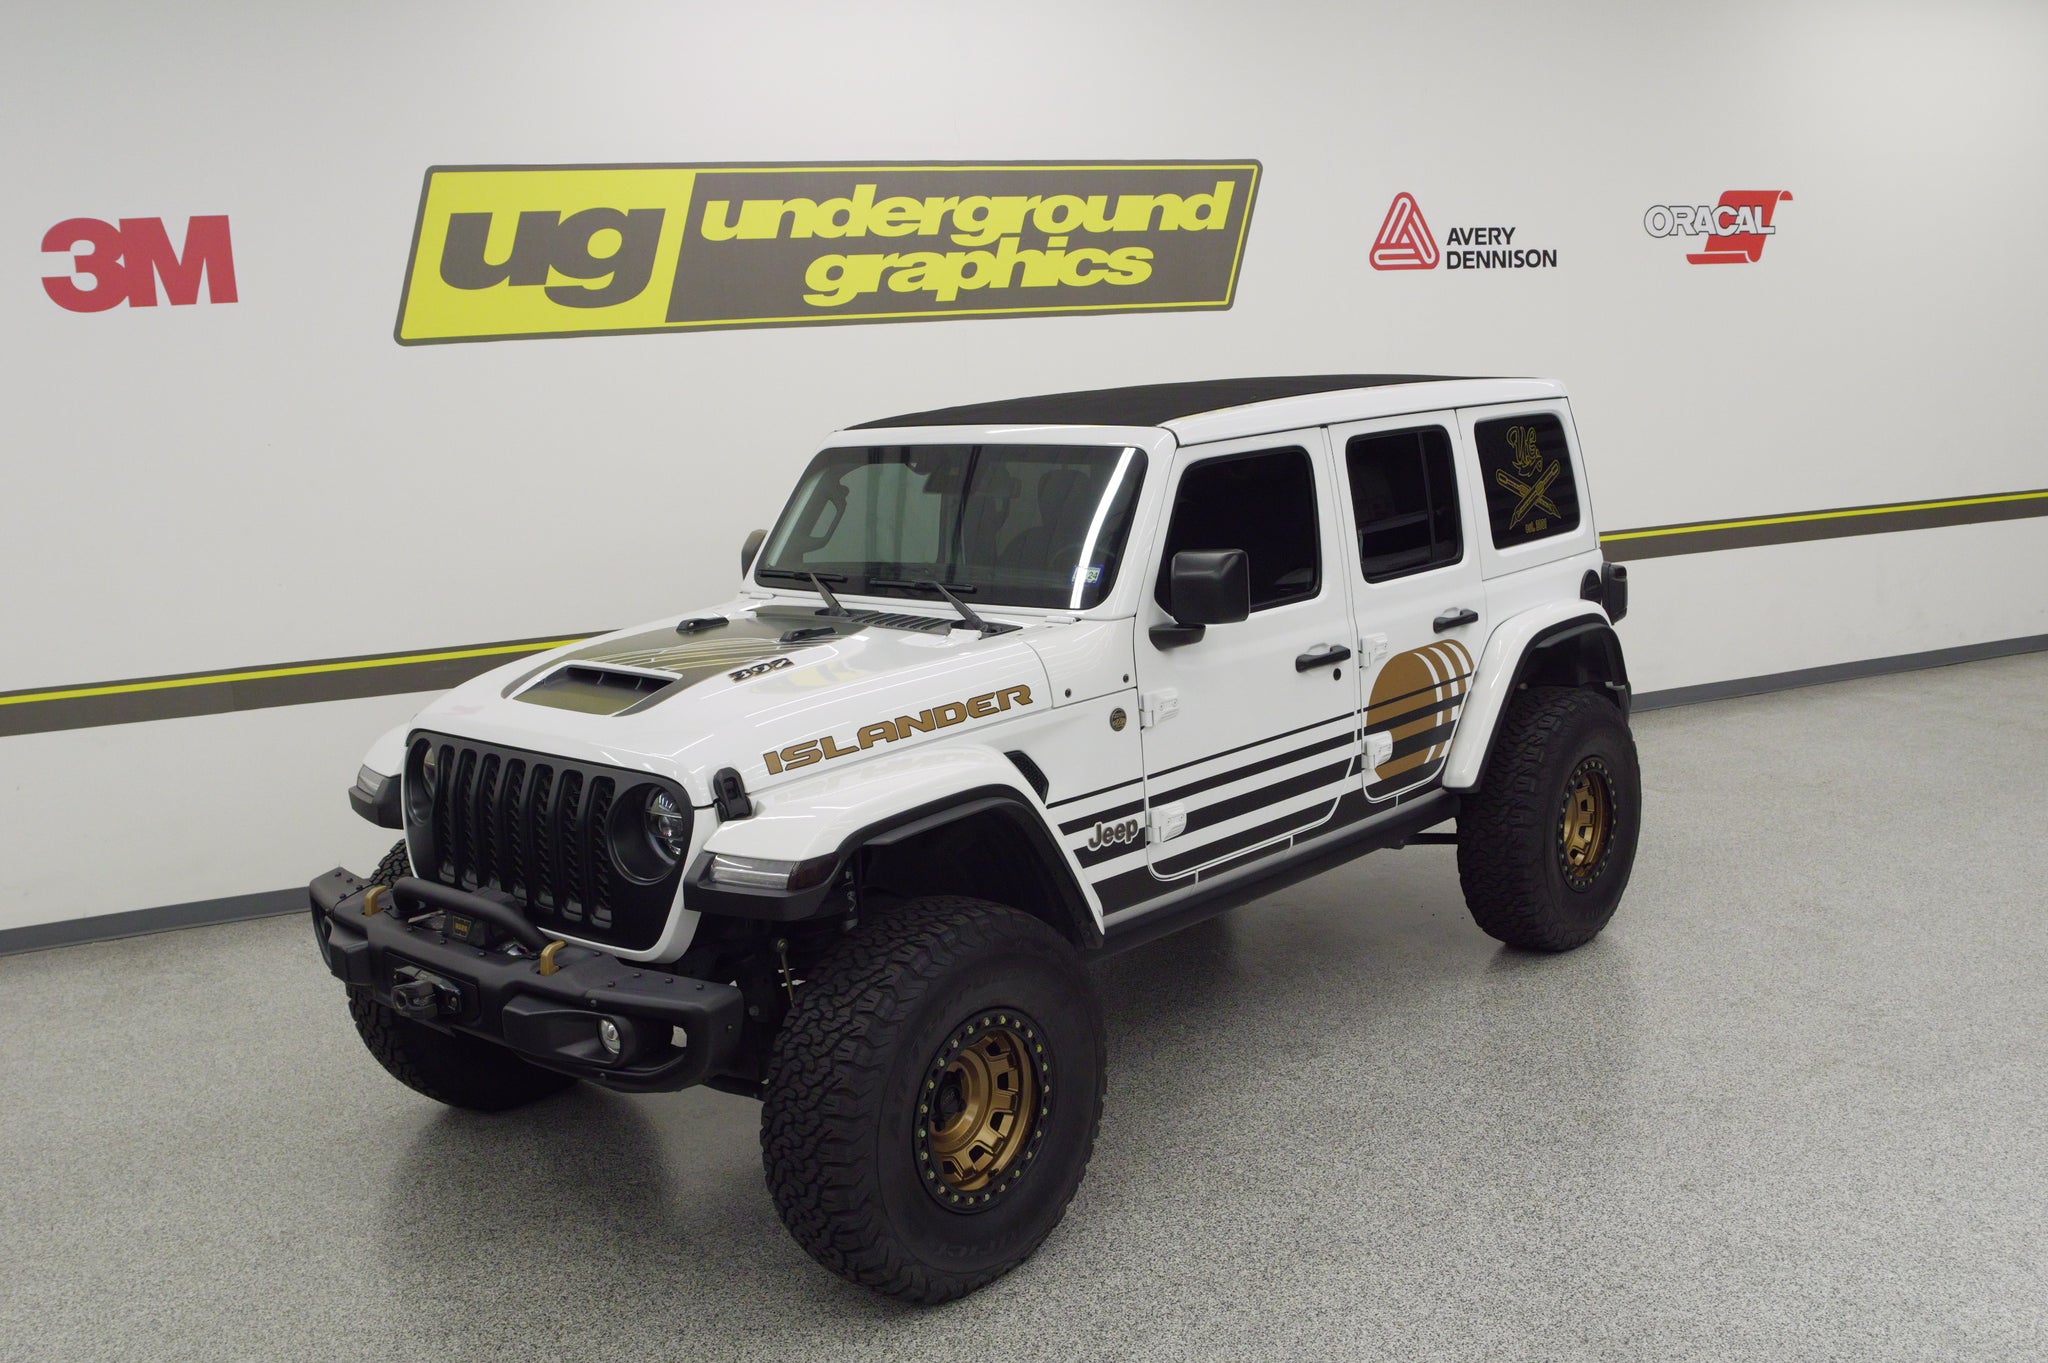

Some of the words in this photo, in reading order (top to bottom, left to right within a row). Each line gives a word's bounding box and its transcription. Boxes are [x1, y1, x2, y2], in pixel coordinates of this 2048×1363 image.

[700, 181, 1235, 247] underground
[1446, 226, 1516, 246] AVERY
[1643, 204, 1776, 239] ORACAL
[41, 214, 238, 313] 3M
[440, 207, 666, 308] ug
[803, 236, 1154, 306] graphics
[1446, 249, 1558, 270] DENNISON
[728, 657, 795, 682] 392
[762, 684, 1034, 775] ISLANDER
[1087, 818, 1139, 850] Jeep
